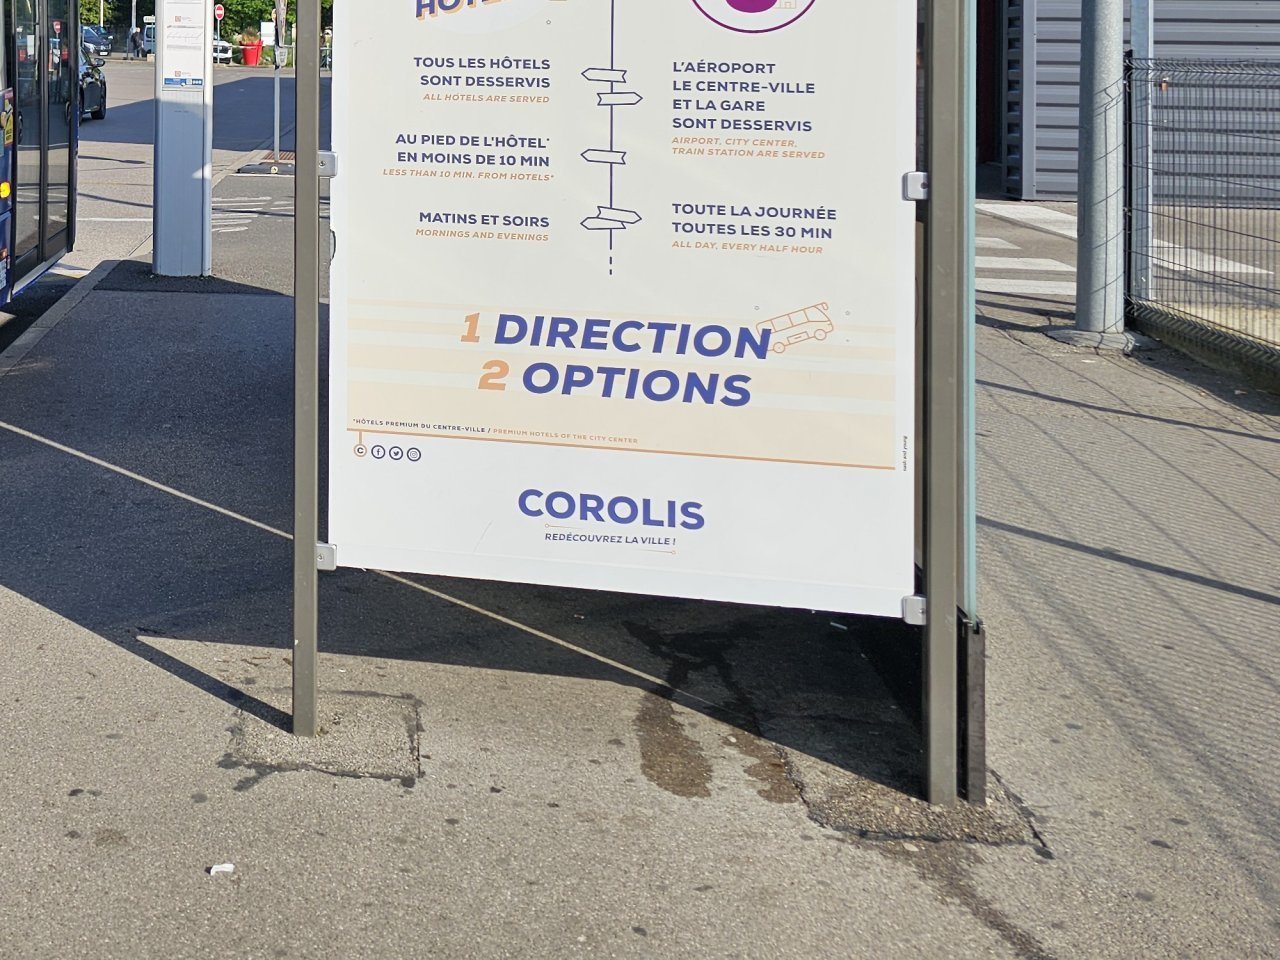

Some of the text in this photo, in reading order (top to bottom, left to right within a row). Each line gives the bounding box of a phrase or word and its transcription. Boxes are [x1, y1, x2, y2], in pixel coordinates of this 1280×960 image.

[414, 56, 551, 70] TOUS LES HÔTELS
[673, 59, 776, 74] L'AÉROPORT
[420, 75, 551, 88] SONT DESSERVIS
[673, 80, 815, 94] LE CENTRE-VILLE
[423, 93, 442, 101] ALL
[509, 95, 550, 103] SERVED
[673, 99, 765, 112] ET LA GARE
[672, 118, 812, 132] SONT DESSERVIS
[395, 134, 417, 145] AU
[421, 134, 455, 146] PIED
[459, 136, 480, 147] DE
[725, 138, 750, 146] CITY
[397, 152, 550, 167] EN MOINS DE 10 MIN
[672, 148, 825, 159] TRAIN STATION ARE SERVED
[410, 169, 437, 177] THAN
[478, 172, 507, 180] FROM
[672, 203, 837, 220] TOUTE LA JOURNÉE
[420, 212, 550, 228] MATINS ET SOIRS
[415, 229, 549, 241] MORNINGS AND EVENINGS
[672, 222, 832, 239] TOUTES LES 30 MIN
[672, 241, 692, 249] ALL
[722, 243, 757, 251] EVERY
[759, 244, 788, 253] HALF
[791, 246, 823, 254] HOUR
[460, 312, 772, 361] 1 DIRECTION
[477, 359, 752, 408] 2 OPTIONS
[433, 424, 485, 433] CENTRE-VILLE
[493, 428, 528, 436] PREMIUM
[518, 489, 705, 530] COROLIS
[545, 532, 622, 544] REDÉCOUVREZ
[625, 536, 638, 544] LA
